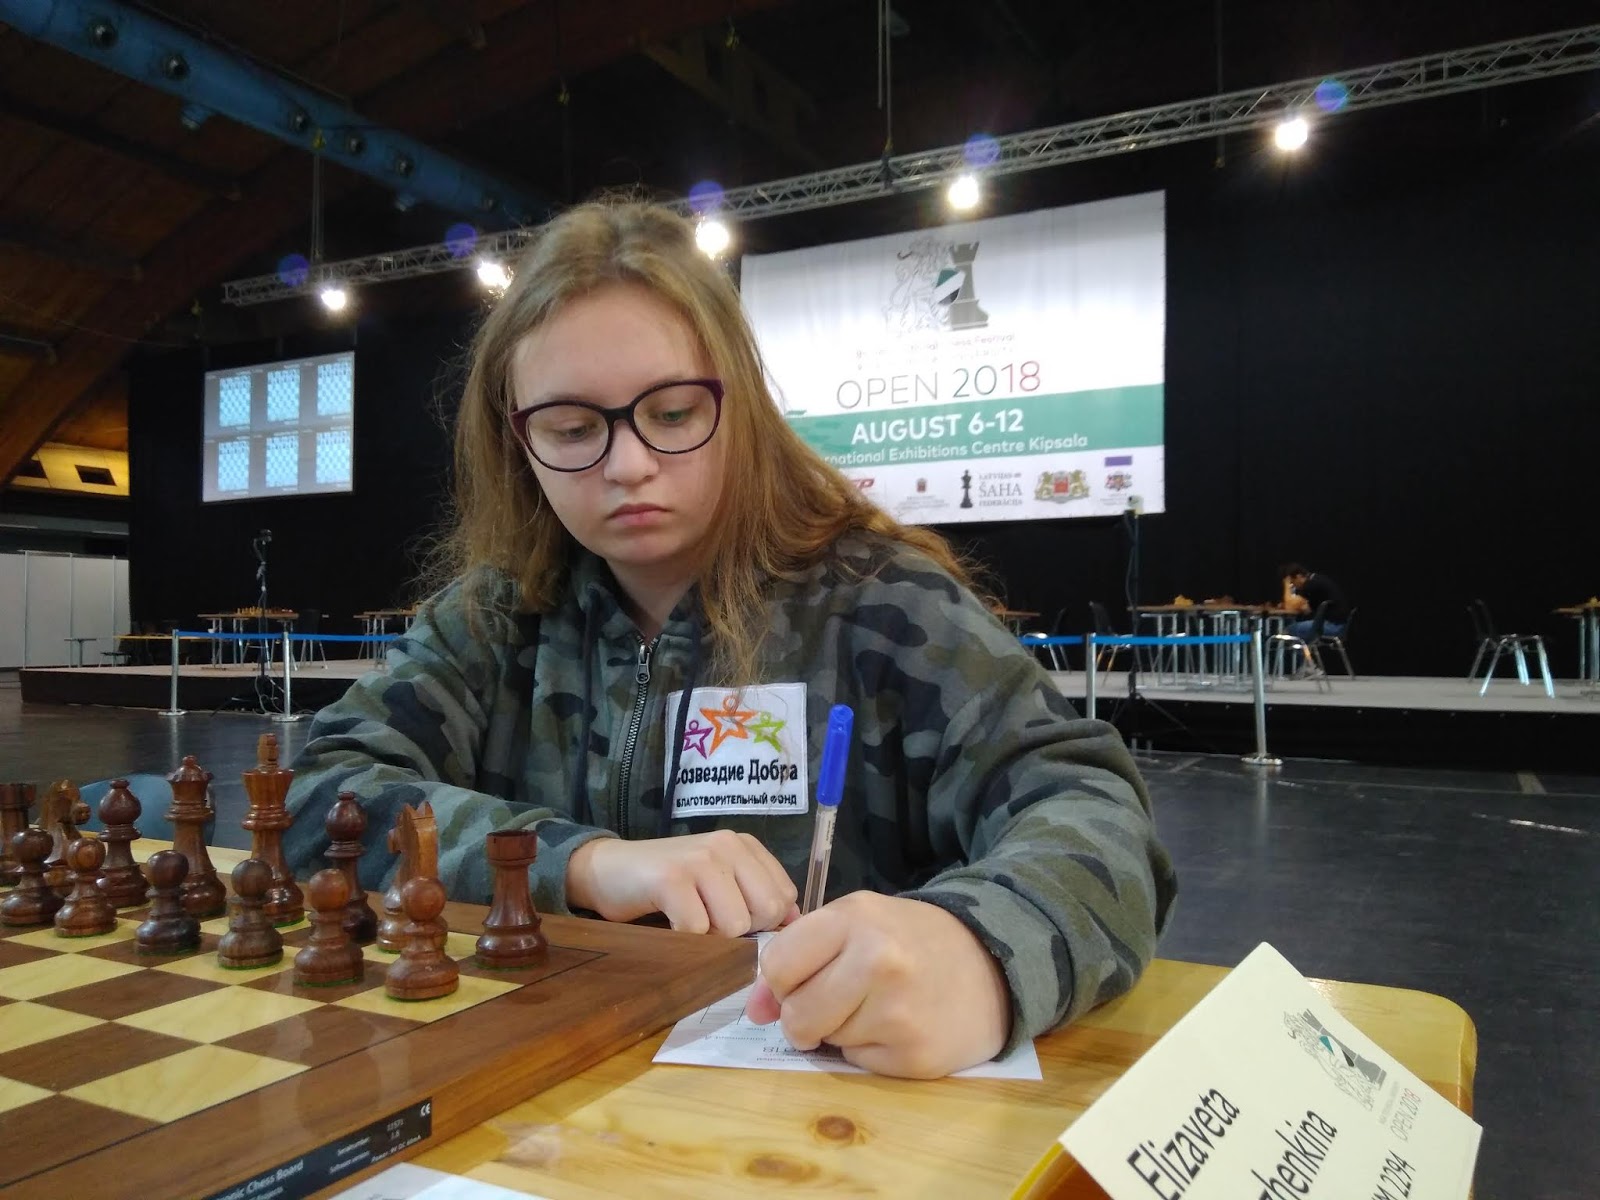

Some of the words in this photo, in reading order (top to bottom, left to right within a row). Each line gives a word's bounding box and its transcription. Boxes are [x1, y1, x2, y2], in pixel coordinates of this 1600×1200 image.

[836, 372, 939, 409] OPEN
[952, 360, 1041, 399] 2018
[851, 413, 962, 445] AUGUST
[967, 408, 1025, 436] 6-12
[825, 449, 885, 466] rnational
[889, 443, 967, 462] Exhibitions
[971, 439, 1025, 456] Centre
[1028, 432, 1089, 453] Kipsala
[978, 481, 1023, 498] ŠAHA
[748, 758, 798, 785] Добра
[1126, 1087, 1241, 1200] Elizaveta
[245, 1175, 275, 1194] Chess
[275, 1159, 304, 1181] Board
[1380, 1149, 1417, 1198] 2294
